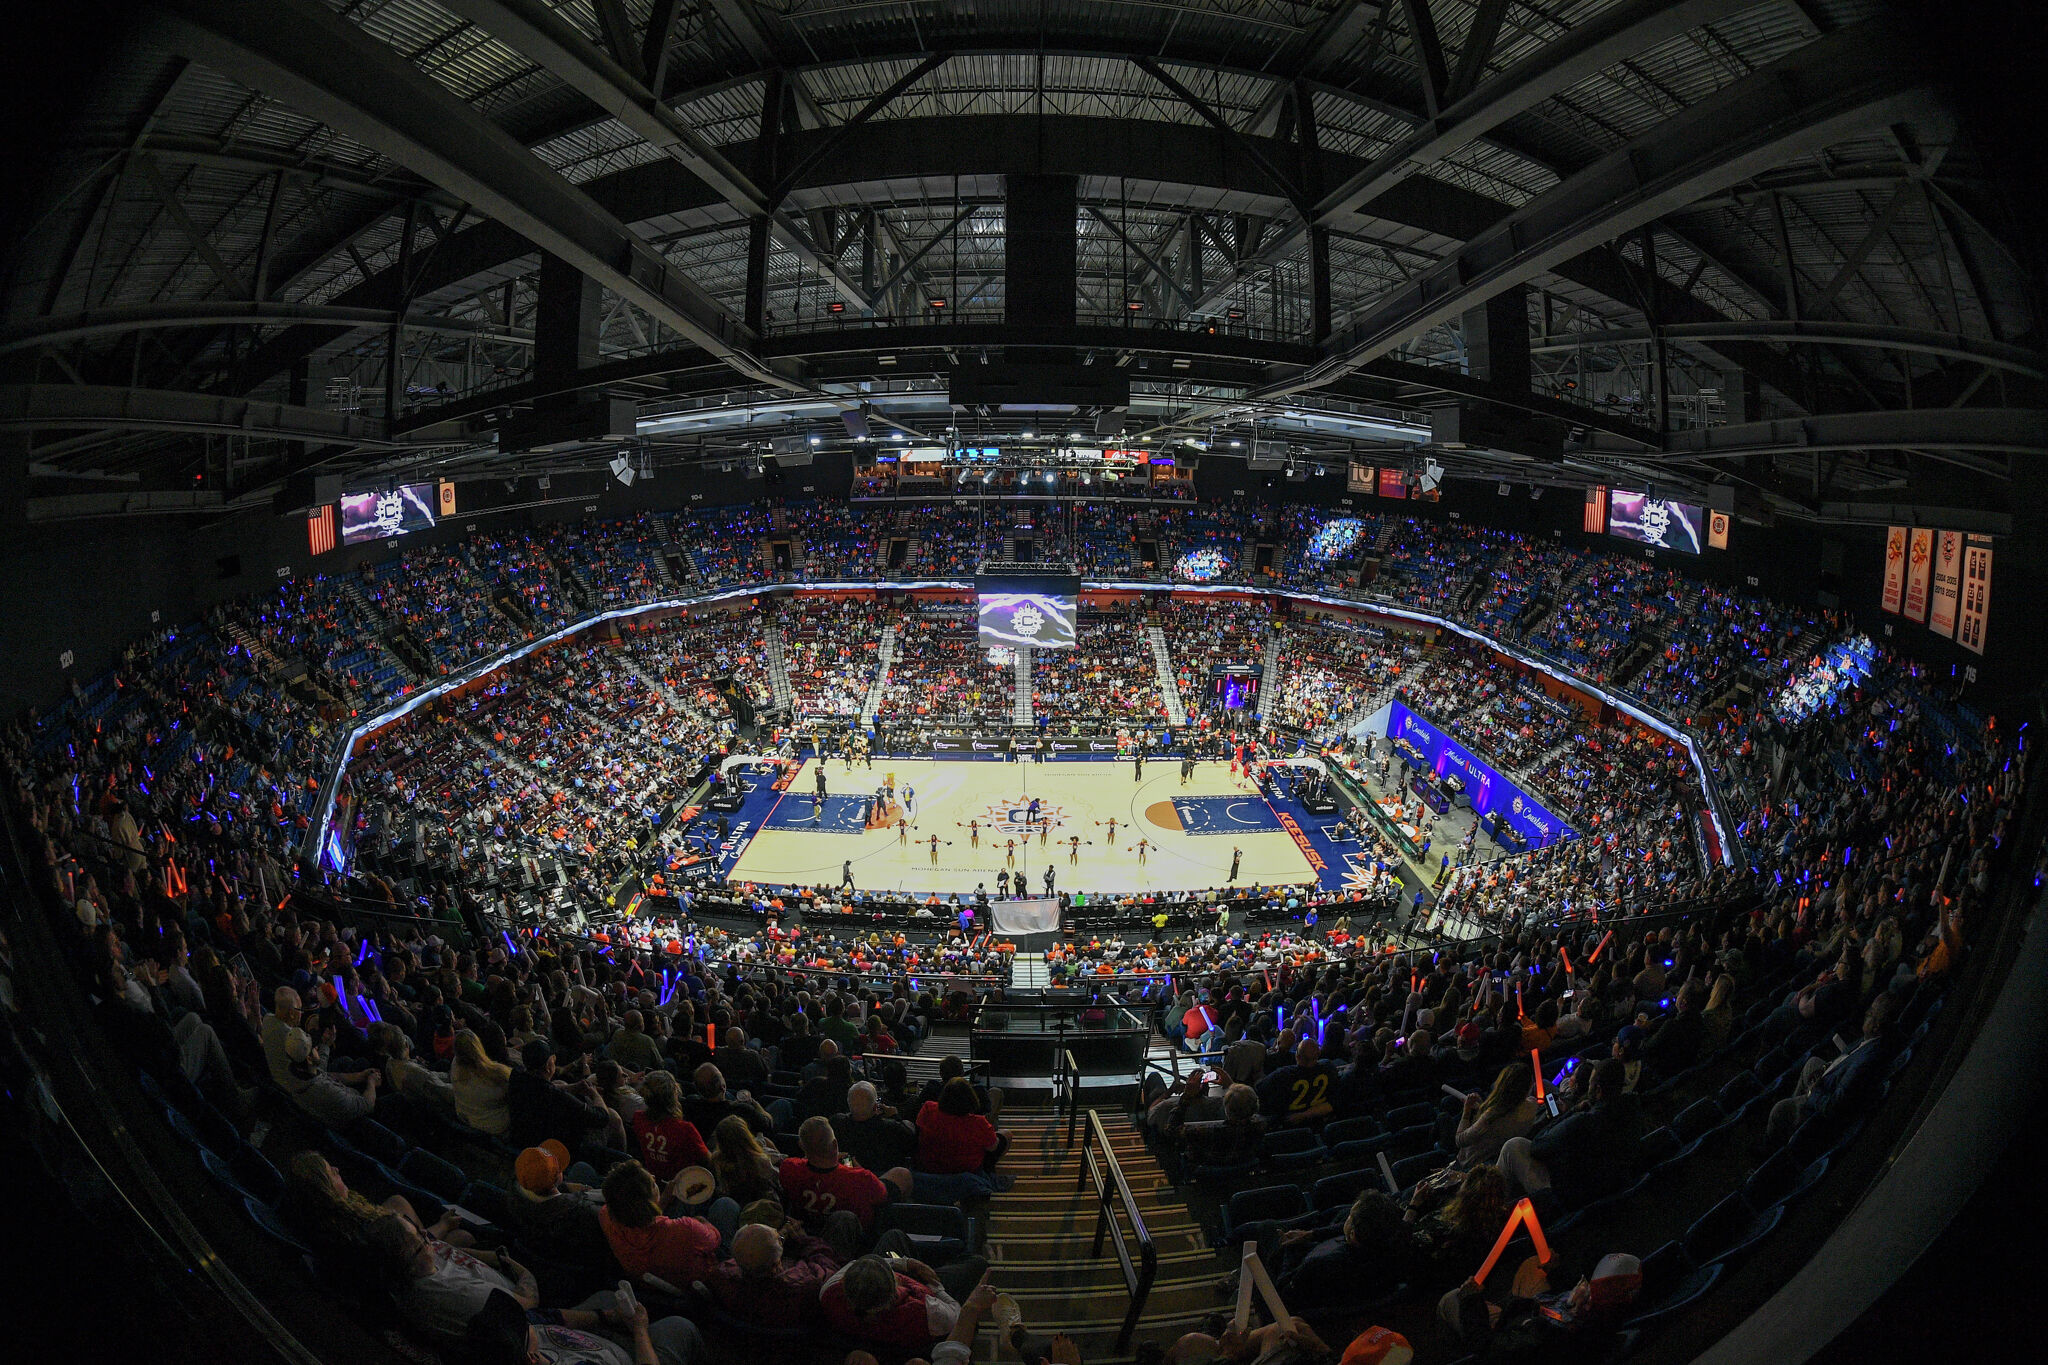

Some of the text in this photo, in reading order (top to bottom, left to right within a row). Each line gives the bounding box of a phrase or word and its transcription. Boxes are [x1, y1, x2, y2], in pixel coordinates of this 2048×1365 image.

[1352, 466, 1373, 482] 10
[691, 493, 703, 501] 104
[585, 505, 597, 513] 103
[1449, 511, 1460, 519] 110
[466, 523, 476, 532] 102
[387, 539, 399, 549] 101
[1645, 549, 1655, 558] 112
[277, 566, 291, 577] 122
[1747, 576, 1759, 587] 113
[60, 649, 74, 669] 120
[1443, 747, 1491, 788] Michelob ULTRA
[1522, 806, 1549, 838] Courtside
[728, 820, 751, 850] ULTRA
[1278, 812, 1329, 871] KEESUSK
[686, 868, 707, 877] SUN
[1288, 1073, 1329, 1111] 22
[645, 1131, 669, 1155] 22
[801, 1189, 837, 1217] 22
